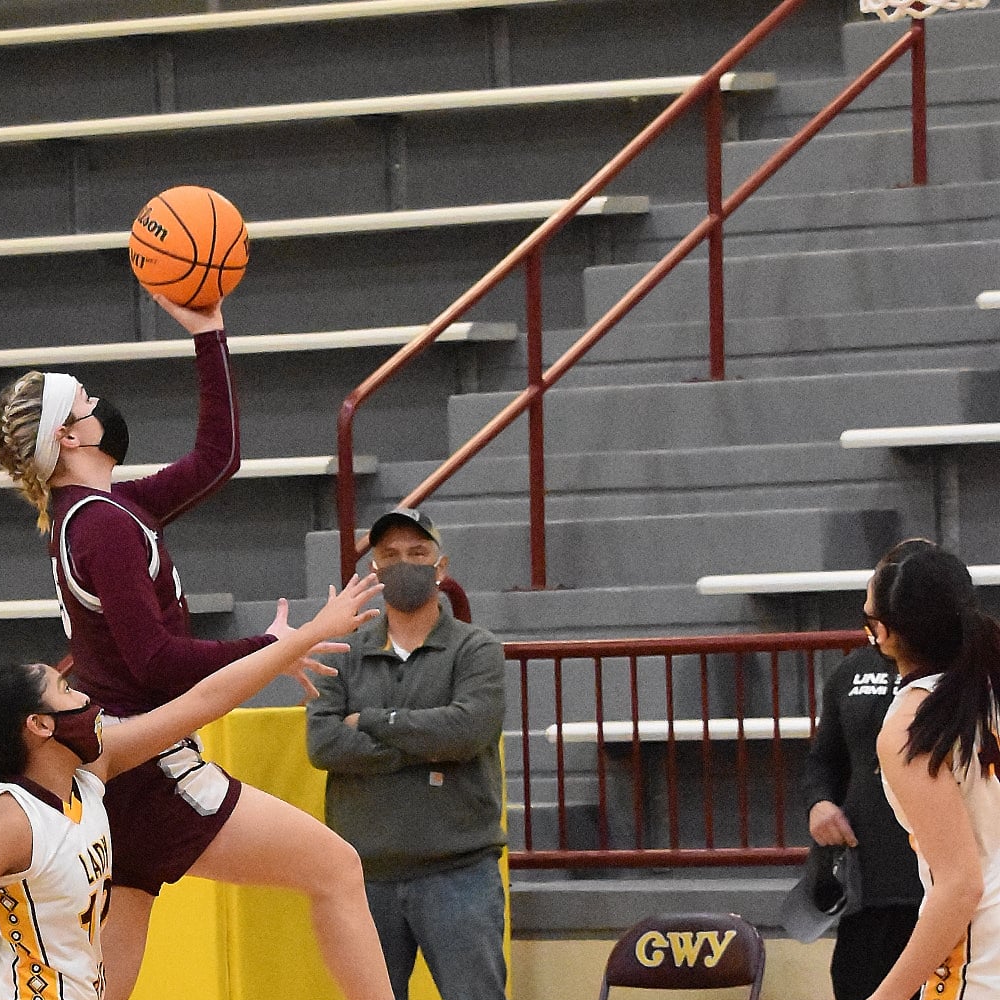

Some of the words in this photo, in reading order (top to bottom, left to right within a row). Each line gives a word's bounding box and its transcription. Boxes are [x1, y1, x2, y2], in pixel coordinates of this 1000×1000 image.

[848, 685, 902, 697] ARMOU
[78, 834, 110, 886] LADY
[635, 930, 737, 968] CWY
